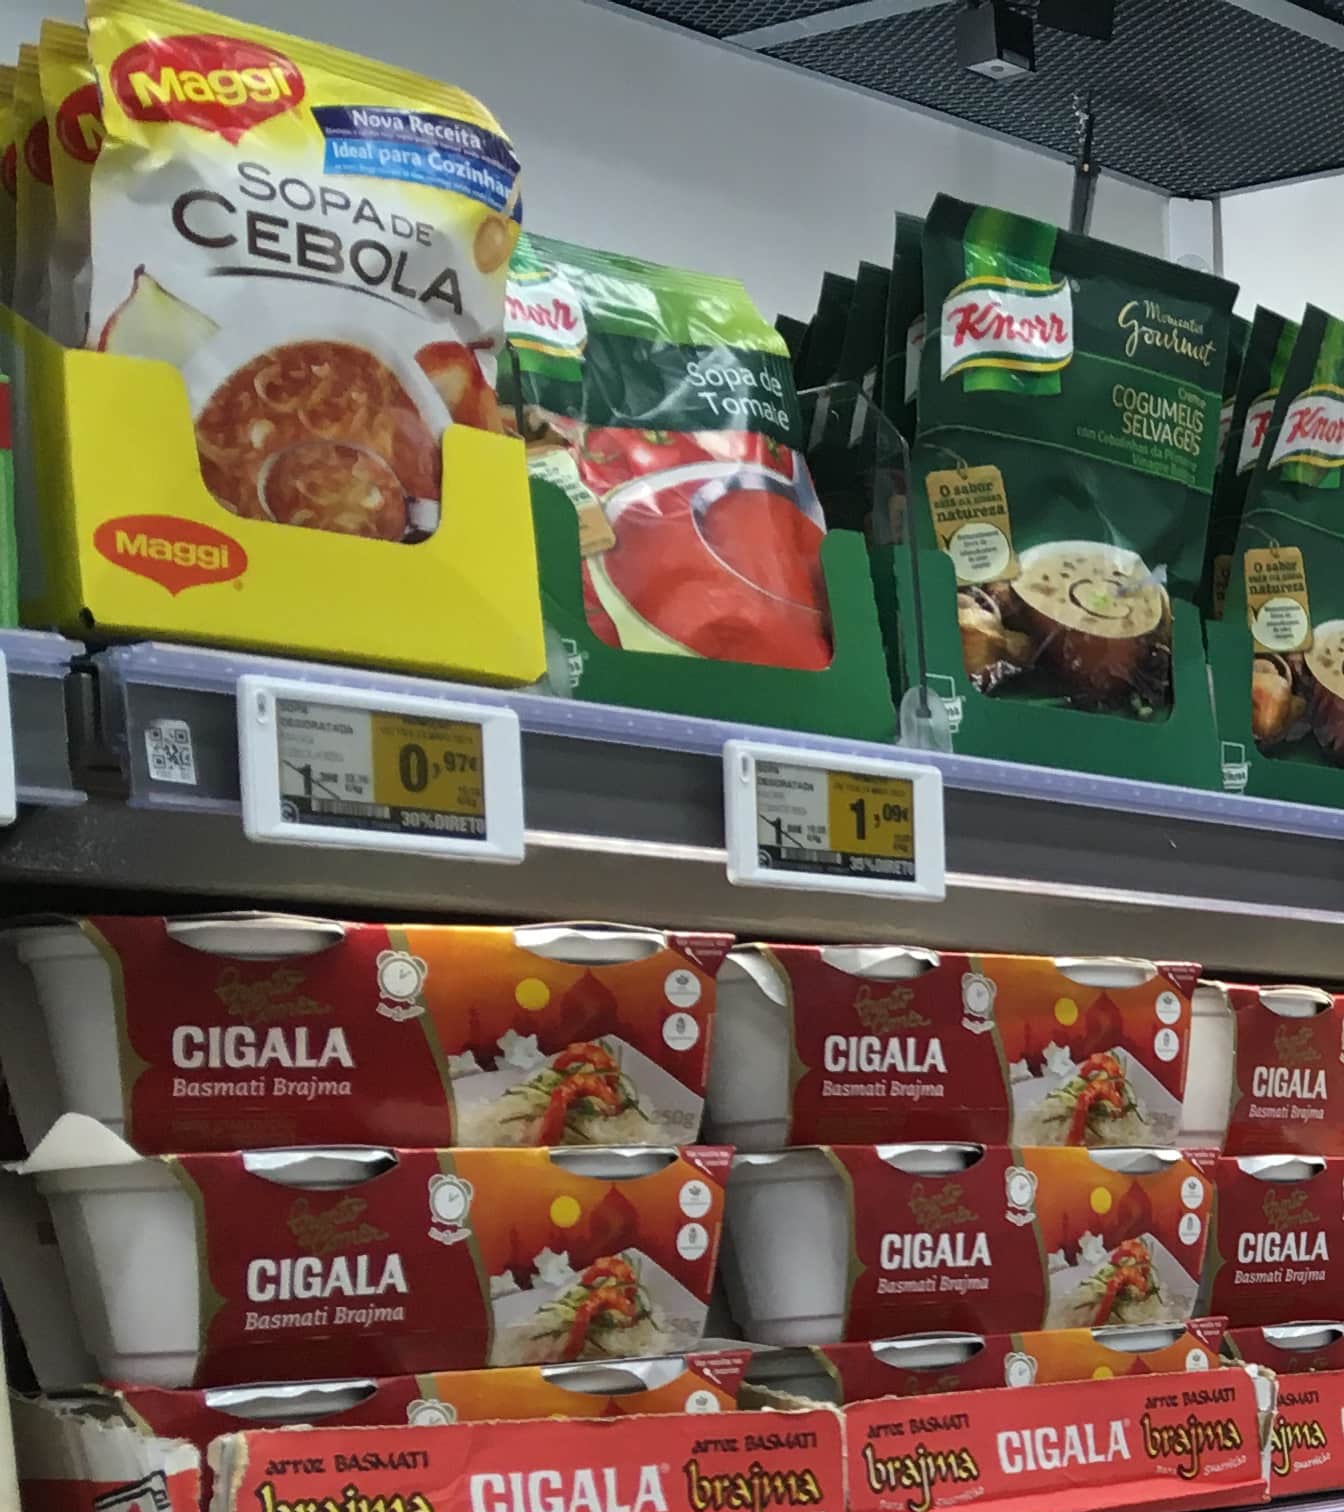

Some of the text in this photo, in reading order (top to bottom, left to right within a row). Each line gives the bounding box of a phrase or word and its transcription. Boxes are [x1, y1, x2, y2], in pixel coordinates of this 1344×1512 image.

[129, 53, 294, 110] Maggi
[352, 110, 480, 149] Nova Receita
[334, 141, 515, 199] Ideal para Cozinhar
[237, 163, 434, 247] SOPA DE
[173, 191, 463, 314] CEBOLA
[949, 302, 1069, 347] Knorr
[689, 359, 782, 395] Sopa de
[116, 525, 229, 571] Maggi
[172, 1026, 354, 1069] CIGALA
[824, 1034, 947, 1073] CIGALA
[173, 1076, 352, 1101] Basmati Brajma
[823, 1080, 944, 1100] Basmati Brajma
[1252, 1067, 1328, 1102] CIGALA
[880, 1233, 992, 1271] CIGALA
[1237, 1232, 1329, 1264] CIGALA
[248, 1255, 407, 1301] CIGALA
[878, 1275, 989, 1294] Basmati Brajma
[245, 1303, 405, 1331] Basmati Brajma
[1183, 1389, 1236, 1406] BASMATI
[746, 1433, 818, 1451] BASMATI
[910, 1415, 969, 1434] BASMATI
[334, 1452, 429, 1472] BASMATI
[999, 1421, 1128, 1473] CIGALA
[1142, 1414, 1242, 1478] brajma
[866, 1443, 979, 1512] brajma
